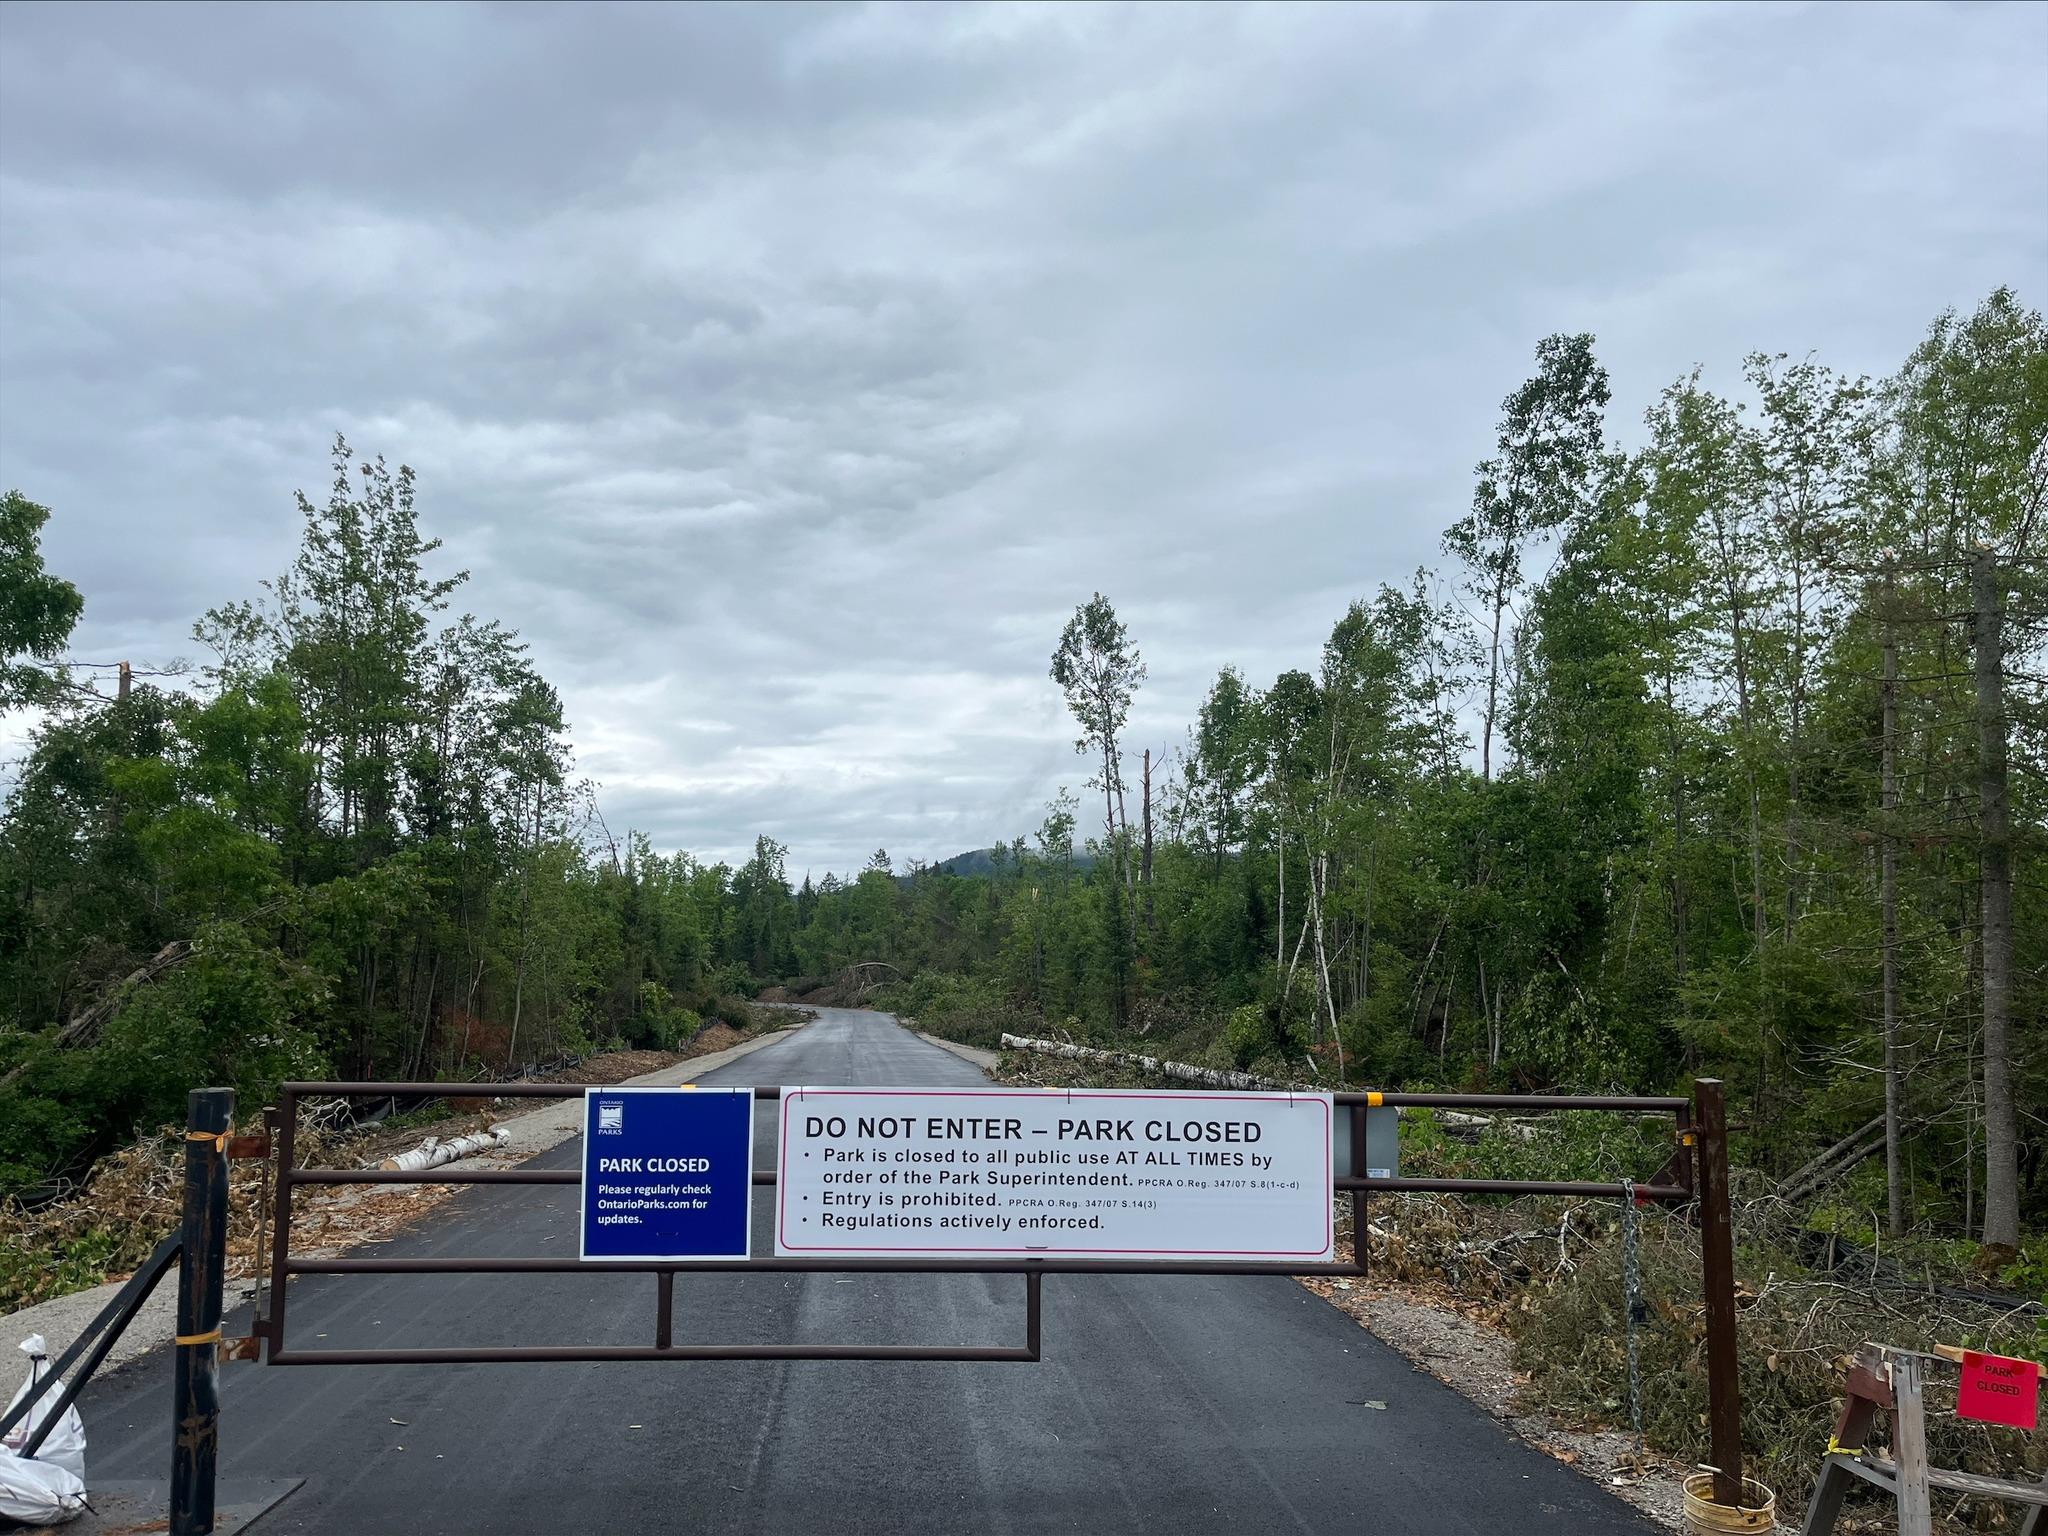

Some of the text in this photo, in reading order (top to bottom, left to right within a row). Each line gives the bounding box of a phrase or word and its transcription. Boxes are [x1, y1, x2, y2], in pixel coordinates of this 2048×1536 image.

[806, 1117, 846, 1138] DO
[858, 1117, 916, 1138] NOT
[927, 1118, 1022, 1139] ENTER
[1058, 1120, 1134, 1140] PARK
[1145, 1121, 1261, 1143] CLOSED
[600, 1159, 709, 1172] PARK CLOSED
[824, 1148, 1272, 1170] Park is closed to all public use AT ALL TIMES by
[823, 1170, 872, 1184] order
[880, 1170, 897, 1184] of
[904, 1171, 932, 1184] the
[939, 1171, 980, 1185] Park
[987, 1171, 1133, 1188] Superintendent.
[1138, 1179, 1173, 1187] PPCRA
[1177, 1180, 1209, 1189] O.Reg.
[1214, 1180, 1246, 1188] 347/07
[599, 1185, 711, 1196] Please regularly check
[598, 1199, 707, 1209] OntarioParks.com for
[823, 1192, 871, 1208] Entry
[879, 1192, 894, 1206] is
[901, 1192, 1002, 1209] prohibited.
[1009, 1199, 1044, 1207] PPCRA
[1048, 1200, 1080, 1209] O.Reg.
[1085, 1200, 1117, 1208] 347/07
[598, 1215, 642, 1225] updates.
[822, 1213, 1104, 1231] Regulations actively enforced.
[1985, 1365, 2013, 1378] PARK
[1977, 1381, 2020, 1395] CLOSED
